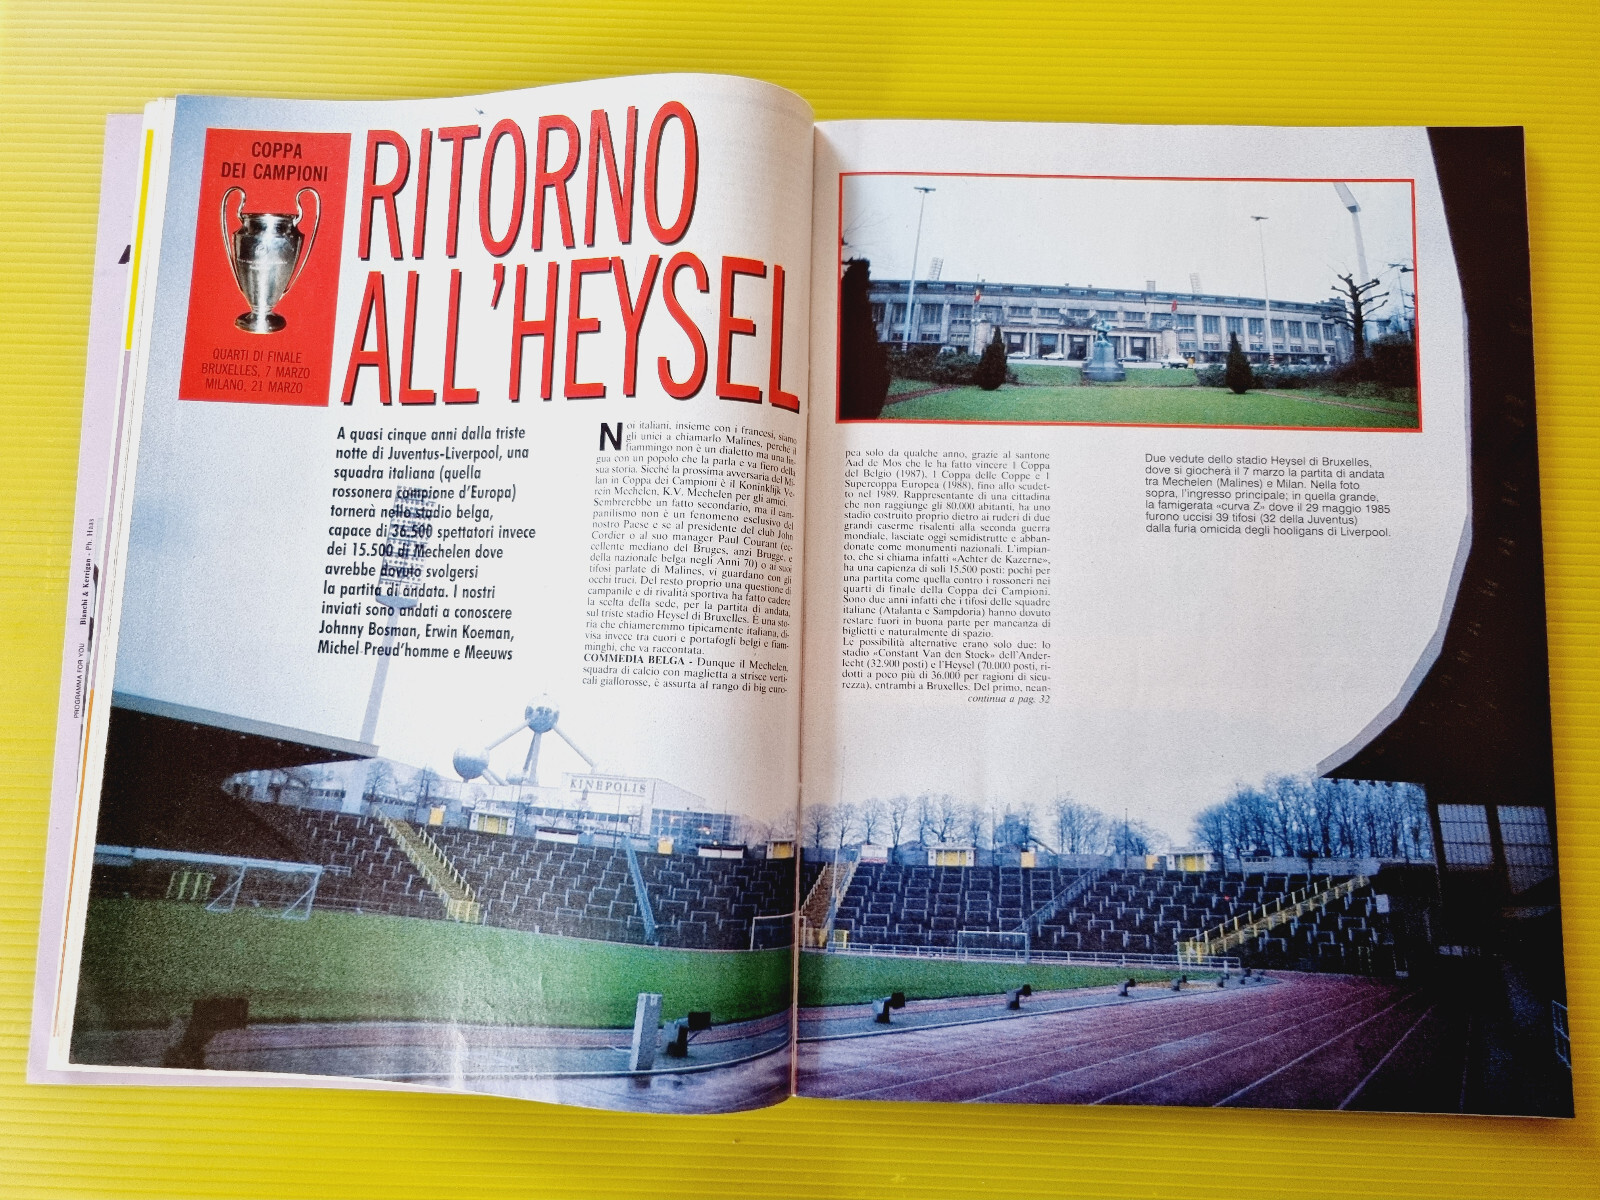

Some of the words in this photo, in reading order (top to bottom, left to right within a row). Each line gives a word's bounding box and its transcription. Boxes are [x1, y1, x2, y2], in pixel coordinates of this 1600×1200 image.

[252, 142, 302, 158] COPPA
[221, 162, 246, 178] DEI
[253, 164, 328, 182] CAMPIONI
[359, 101, 699, 259] RITORNO
[341, 251, 800, 413] ALL'HEYSEL
[213, 349, 249, 361] QUARTI
[253, 350, 263, 362] DI
[268, 351, 302, 363] FINALE
[201, 363, 260, 377] BRUXELLES,
[265, 366, 271, 377] 7
[276, 367, 310, 379] MARZO
[205, 379, 246, 392] MILANO,
[251, 381, 262, 392] 21
[268, 381, 303, 393] MARZO
[337, 427, 345, 439] A
[350, 428, 383, 443] quasi
[388, 428, 426, 444] cinque
[431, 428, 457, 440] anni
[462, 426, 491, 440] dalla
[496, 427, 525, 439] triste
[336, 448, 367, 459] notte
[372, 446, 383, 459] di
[388, 445, 502, 462] Juventus-Liverpool,
[507, 449, 528, 458] una
[1145, 453, 1166, 463] Due
[1169, 454, 1204, 466] vedute
[1208, 455, 1233, 464] dello
[1236, 456, 1267, 464] stadio
[1271, 456, 1305, 467] Heysel
[1309, 457, 1318, 466] di
[1322, 457, 1372, 468] Bruxelles,
[334, 465, 383, 481] squadra
[389, 465, 434, 479] italiana
[440, 465, 481, 482] (quella
[1145, 465, 1170, 474] dove
[1186, 466, 1231, 477] giocherà
[1234, 467, 1240, 476] il
[1243, 467, 1249, 475] 7
[1253, 469, 1285, 477] marzo
[1288, 468, 1297, 477] la
[1300, 469, 1333, 479] partita
[1336, 469, 1345, 478] di
[1349, 470, 1385, 479] andata
[1145, 477, 1158, 486] tra
[1162, 476, 1212, 487] Mechelen
[1217, 478, 1263, 490] (Malines)
[1276, 479, 1306, 489] Milan.
[1310, 480, 1337, 490] Nella
[1340, 480, 1360, 490] foto
[332, 488, 392, 498] rossonera
[396, 486, 454, 502] campione
[459, 484, 516, 502] d'Europa)
[904, 490, 974, 501] Rappresentante
[1146, 490, 1179, 501] sopra,
[1182, 488, 1231, 500] l'ingresso
[1235, 490, 1288, 501] principale;
[1305, 492, 1336, 502] quella
[1339, 493, 1379, 503] grande,
[330, 504, 375, 518] tornerà
[381, 503, 411, 518] nello
[414, 504, 451, 519] stadio
[456, 504, 493, 522] belga,
[1146, 500, 1154, 509] la
[1158, 500, 1213, 513] famigerata
[1217, 503, 1250, 512] «curva
[1253, 501, 1265, 512] Z»
[1269, 502, 1294, 512] dove
[1298, 503, 1302, 511] il
[1306, 503, 1319, 512] 29
[1322, 505, 1362, 516] maggio
[1366, 504, 1391, 514] 1985
[1145, 511, 1180, 521] furono
[1183, 513, 1212, 522] uccisi
[1216, 512, 1229, 522] 39
[1232, 512, 1256, 523] tifosi
[1260, 513, 1276, 524] (32
[1279, 514, 1304, 525] della
[1307, 515, 1358, 526] Juventus)
[328, 526, 371, 539] capace
[376, 524, 388, 538] di
[391, 524, 432, 538] 36.500
[437, 526, 494, 541] spettatori
[499, 525, 536, 539] invece
[1146, 523, 1171, 533] dalla
[1174, 524, 1196, 533] furia
[1200, 524, 1241, 534] omicida
[1244, 525, 1270, 537] degli
[1273, 526, 1324, 538] hooligans
[1327, 527, 1337, 536] di
[1340, 527, 1391, 539] Liverpool.
[327, 541, 346, 555] dei
[353, 542, 394, 557] 15.500
[397, 543, 409, 557] di
[412, 543, 470, 558] Mechelen
[475, 544, 503, 558] dove
[82, 558, 91, 588] Kerrigan
[325, 561, 376, 576] avrebbe
[380, 562, 422, 577] dovuto
[426, 564, 478, 582] svolgersi
[324, 580, 335, 594] la
[340, 583, 382, 598] partita
[386, 582, 399, 597] di
[403, 583, 448, 598] andata.
[454, 584, 457, 598] I
[463, 586, 495, 598] nostri
[80, 599, 88, 626] Bianchi
[322, 601, 361, 615] inviati
[366, 603, 395, 616] sono
[399, 603, 438, 617] andati
[442, 608, 449, 618] a
[454, 609, 512, 619] conoscere
[319, 620, 364, 638] Johnny
[368, 622, 420, 639] Bosman,
[426, 624, 457, 638] Erwin
[462, 625, 514, 642] Koeman,
[318, 640, 359, 654] Michel
[364, 642, 448, 658] Preud'homme
[453, 649, 460, 658] e
[464, 645, 512, 660] Meeuws
[584, 654, 644, 664] COMMEDIA
[648, 655, 684, 665] BELGA
[697, 657, 735, 670] Dunque
[749, 660, 789, 673] Mechelen,
[74, 674, 83, 719] PROGRAMMA
[1018, 696, 1036, 705] pag.
[1040, 694, 1051, 703] 32
[570, 779, 646, 793] KINEPOLIS
